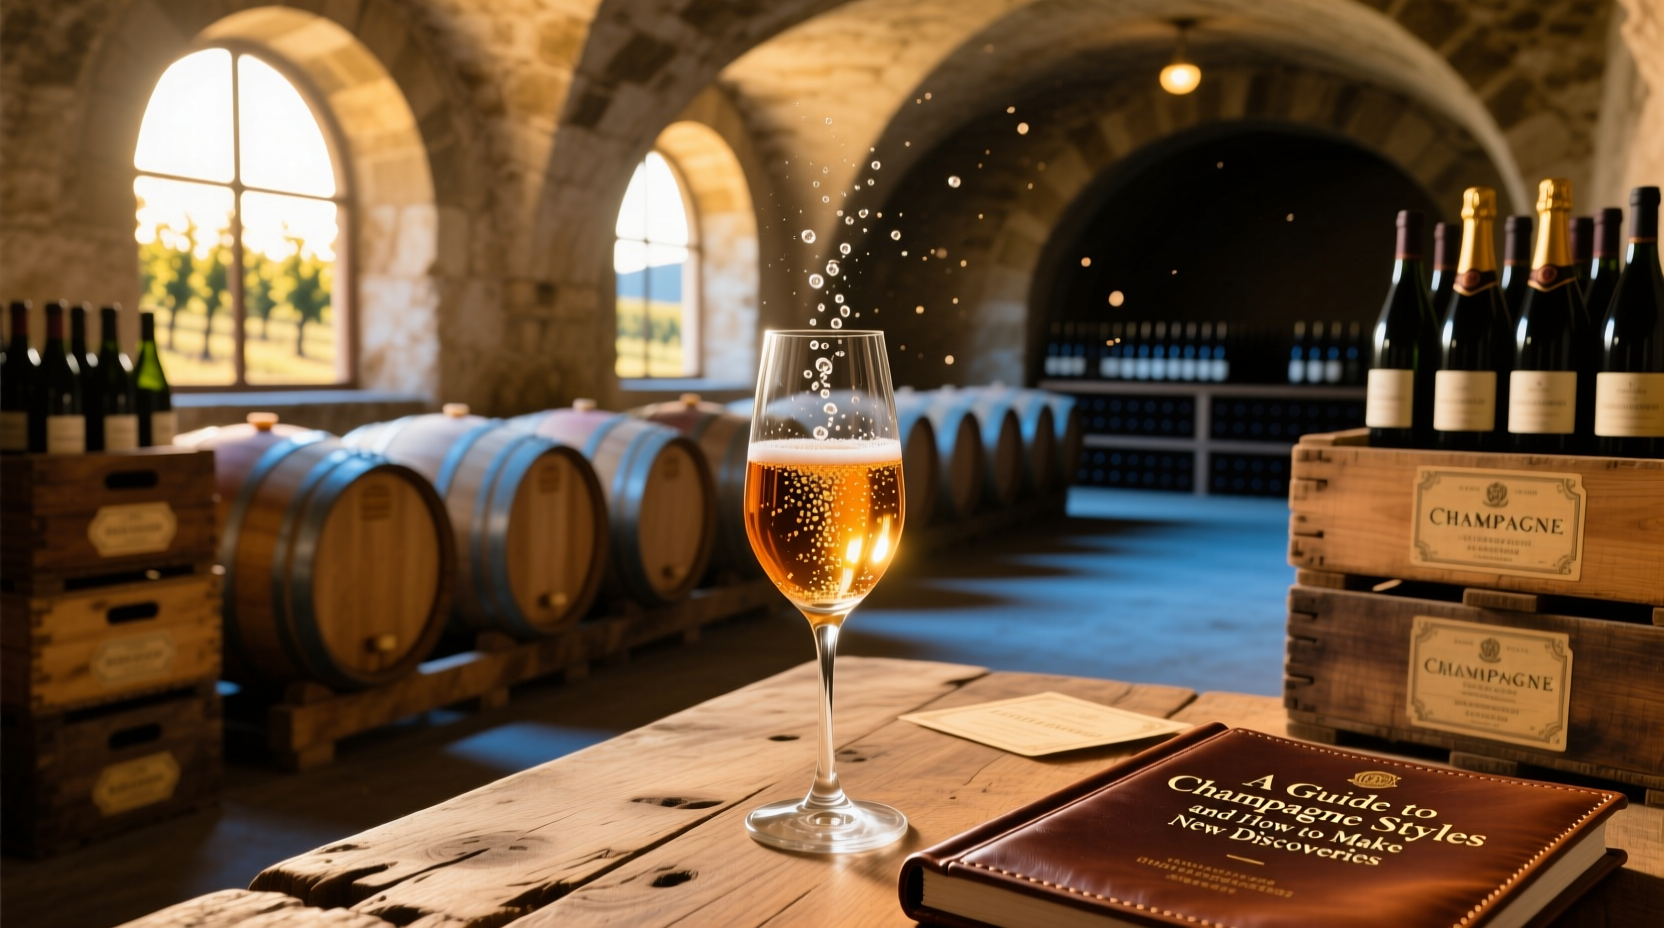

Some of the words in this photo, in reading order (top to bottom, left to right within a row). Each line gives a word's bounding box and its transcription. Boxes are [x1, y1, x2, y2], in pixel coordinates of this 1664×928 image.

[1429, 507, 1564, 535] CHAMPAGNE
[1424, 657, 1554, 692] CHAMPAGNE
[1168, 775, 1363, 826] Champagne
[1371, 816, 1487, 847] Styles
[1242, 774, 1274, 791] A
[1286, 783, 1391, 812] Guide
[1401, 804, 1438, 819] to
[1167, 814, 1227, 835] New
[1229, 827, 1382, 866] Discoveries
[1188, 805, 1237, 820] and
[1236, 814, 1295, 832] How
[1298, 827, 1324, 839] to
[1329, 830, 1403, 853] Make
